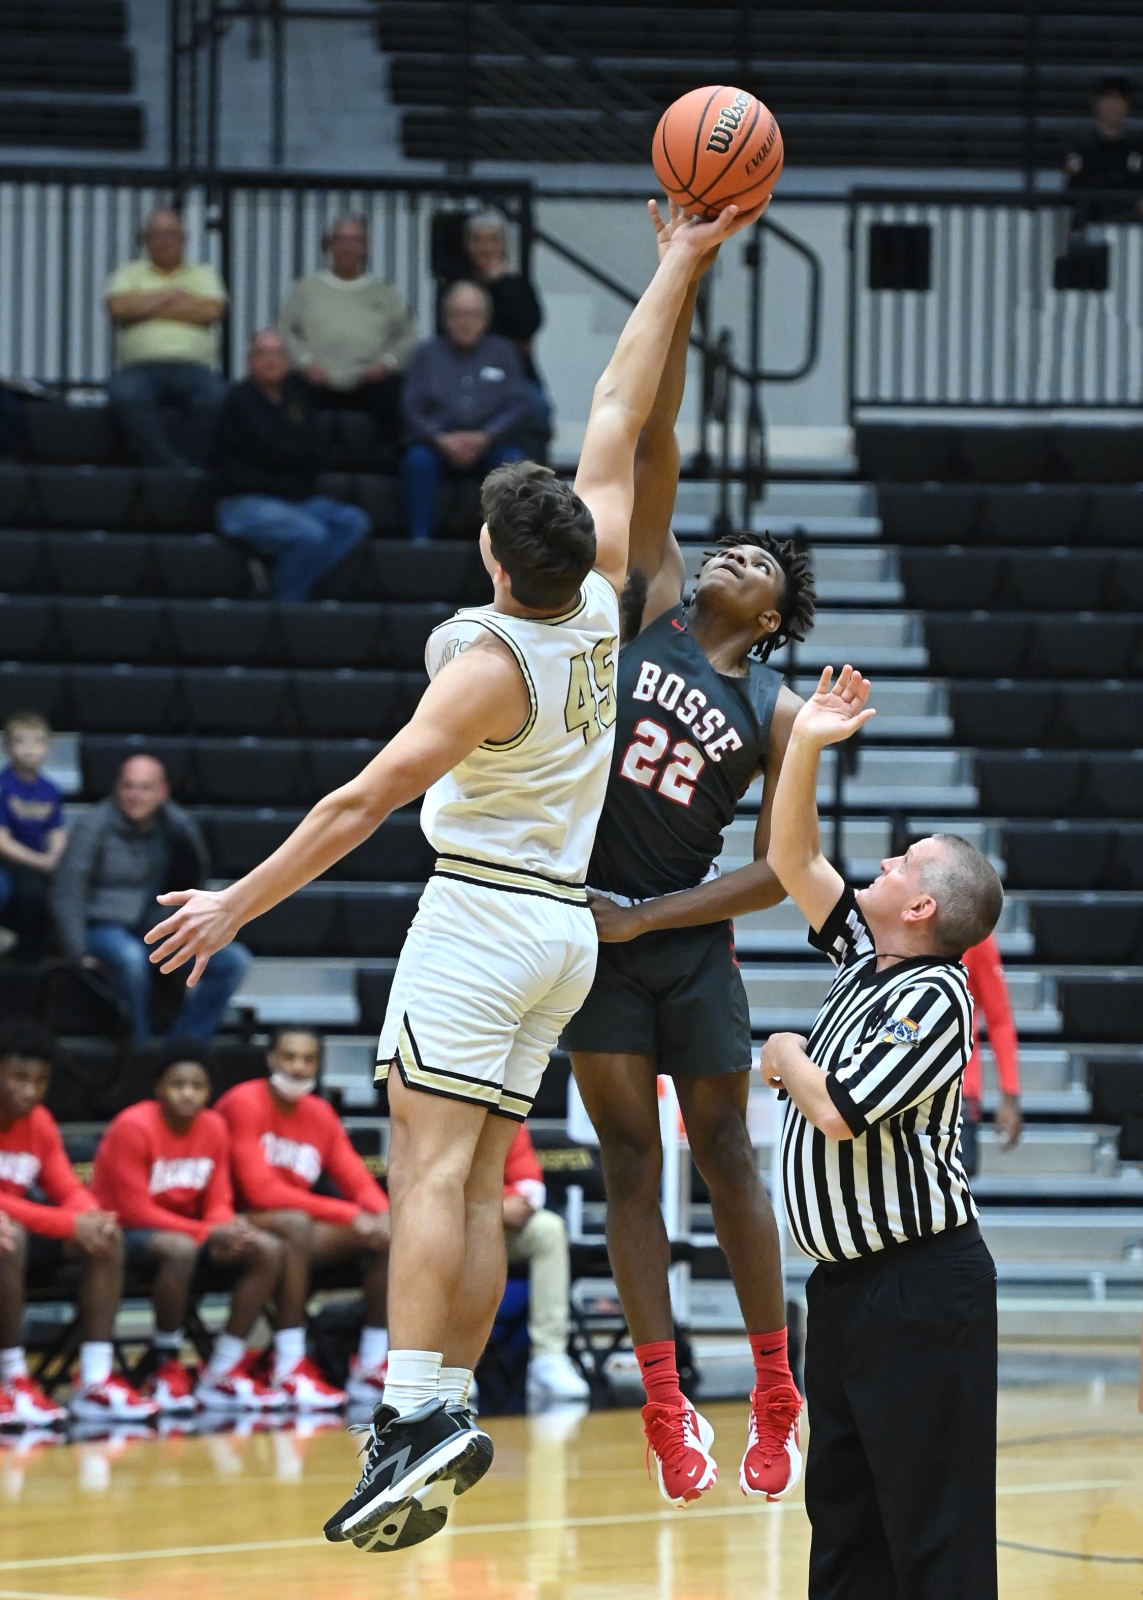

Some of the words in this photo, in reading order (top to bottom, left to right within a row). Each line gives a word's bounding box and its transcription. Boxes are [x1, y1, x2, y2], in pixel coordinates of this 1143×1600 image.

[705, 91, 753, 155] Wilson
[564, 635, 617, 745] 45
[632, 660, 743, 763] BOSSE
[619, 717, 706, 808] 22
